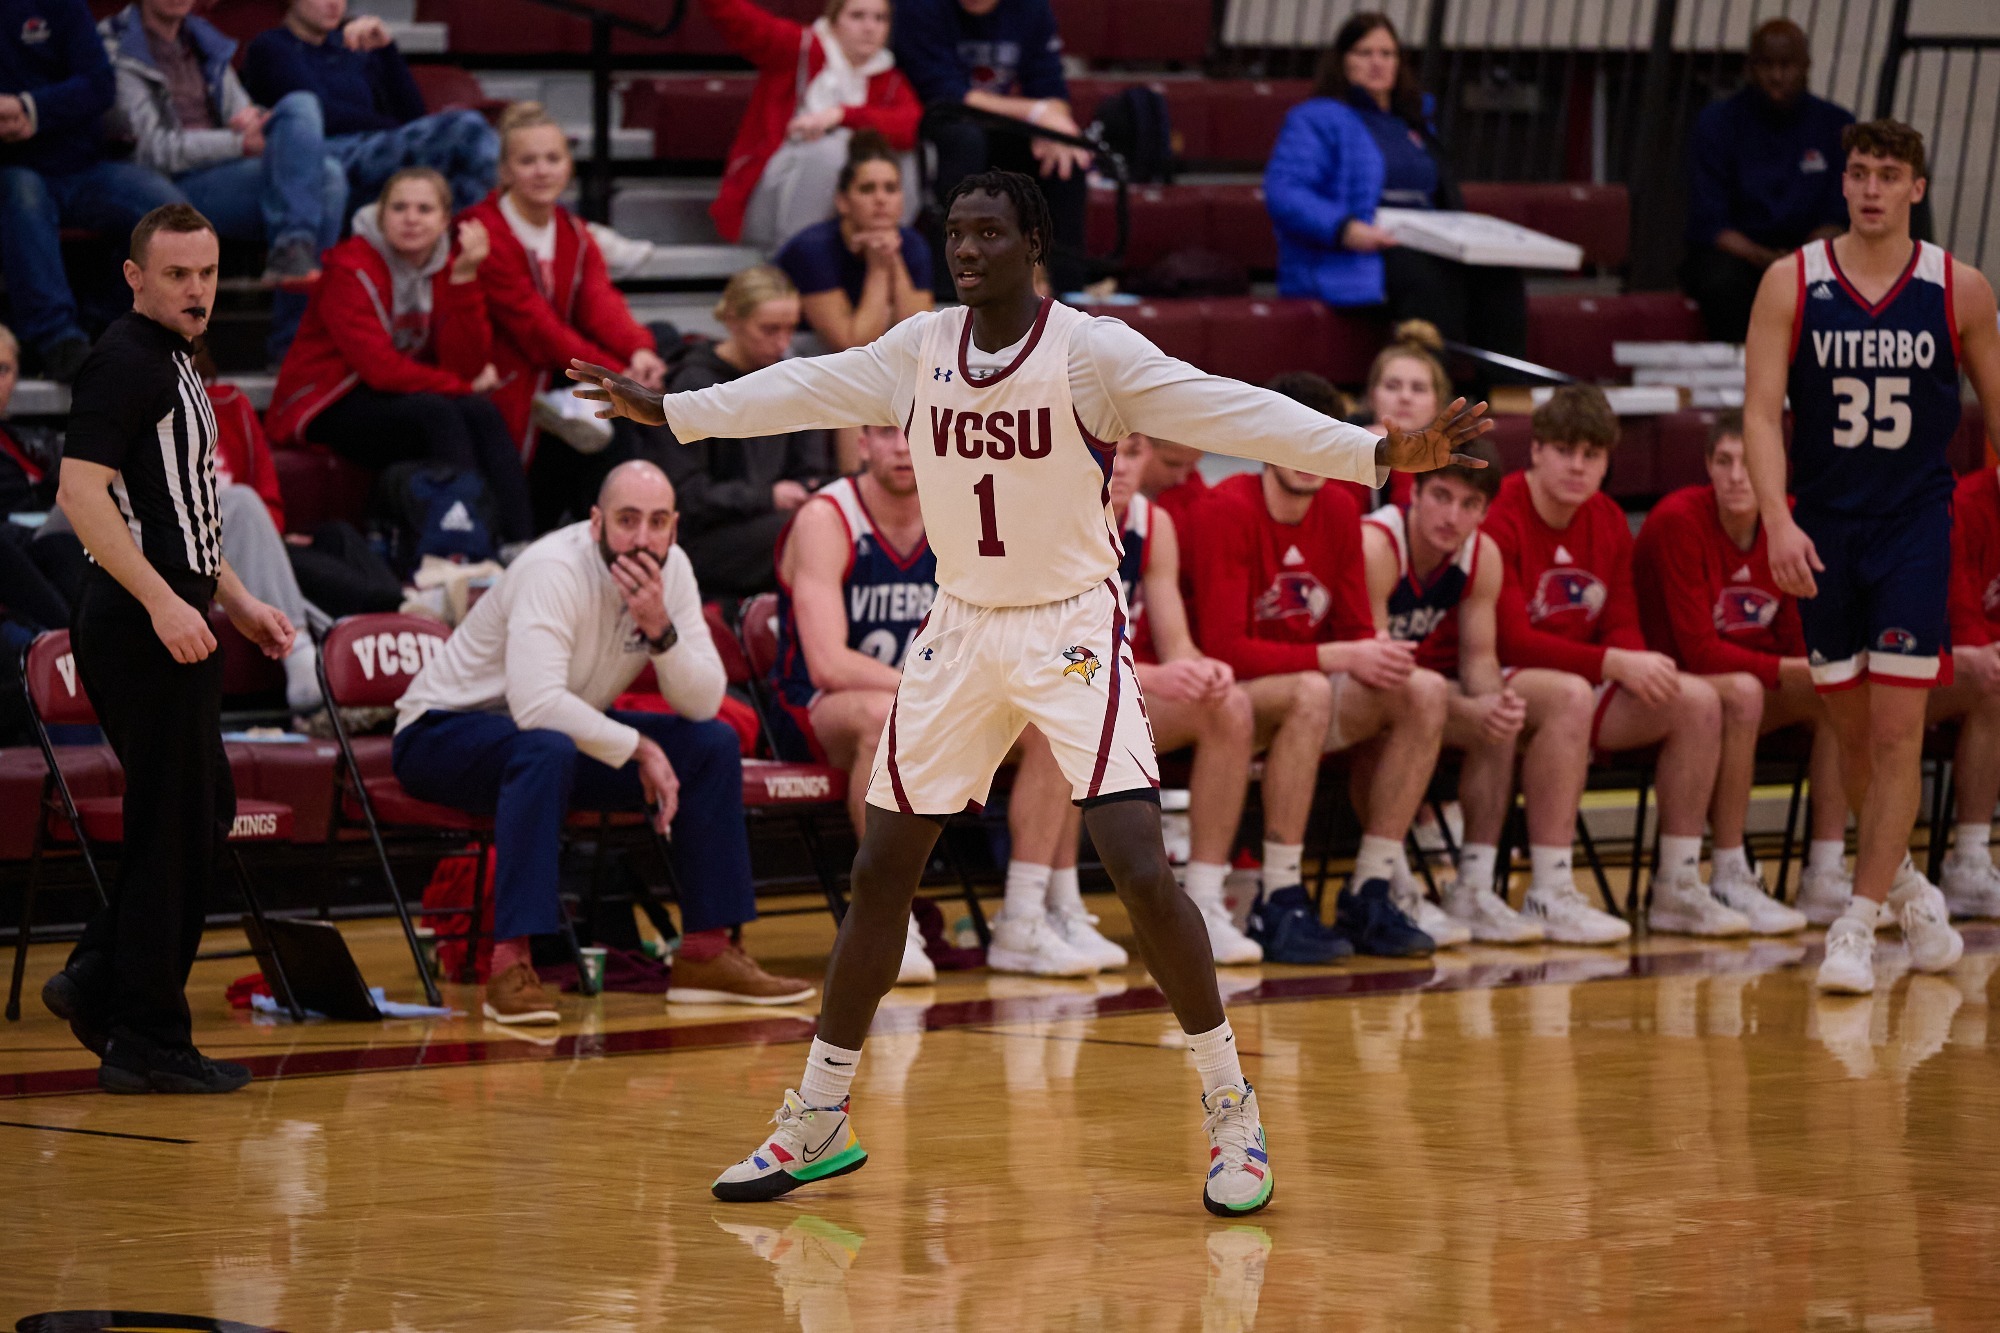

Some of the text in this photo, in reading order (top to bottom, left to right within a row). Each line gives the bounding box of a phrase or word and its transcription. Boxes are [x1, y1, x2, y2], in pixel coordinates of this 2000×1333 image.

[1812, 329, 1936, 369] VITERBO
[930, 405, 1052, 460] VCSU
[1832, 376, 1912, 450] 35
[973, 473, 1006, 557] 1
[851, 582, 936, 622] VITERB
[764, 775, 830, 799] VIKINGS
[228, 813, 278, 838] KINGS
